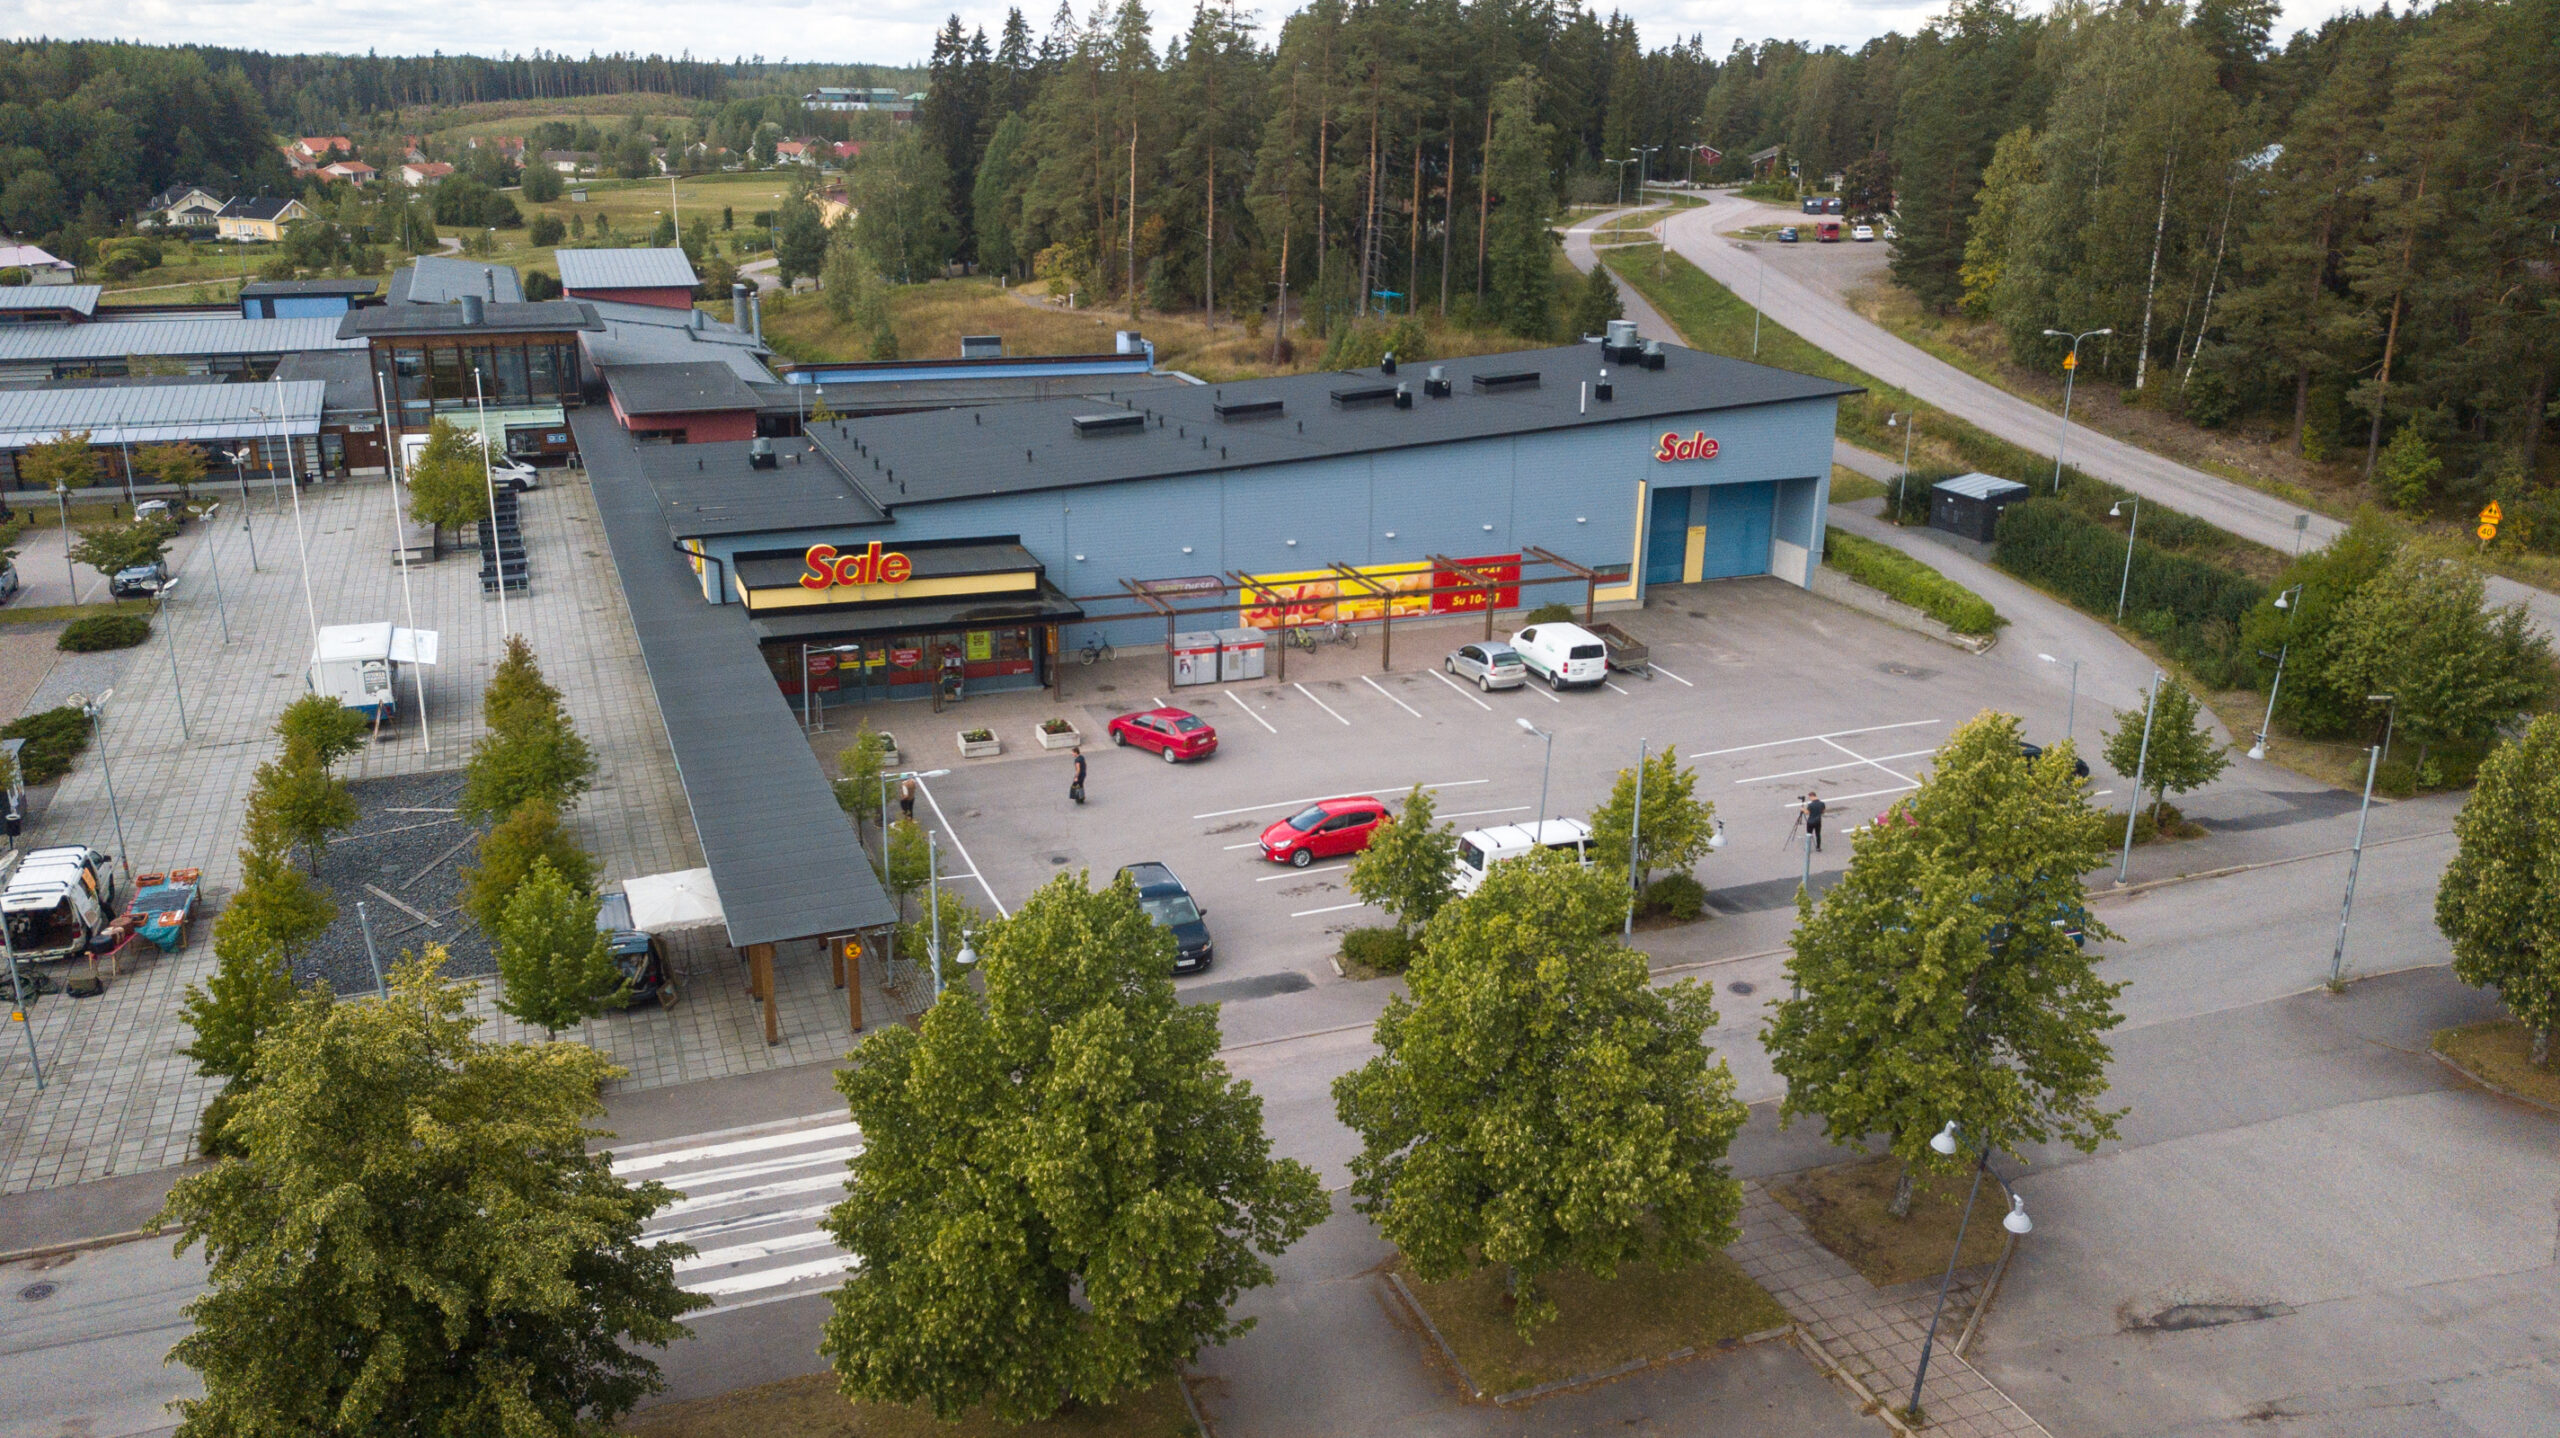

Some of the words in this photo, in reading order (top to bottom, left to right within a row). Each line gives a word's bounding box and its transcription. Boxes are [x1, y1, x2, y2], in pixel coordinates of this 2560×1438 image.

[1655, 431, 1719, 463] Sale
[2481, 528, 2493, 536] 40
[799, 541, 912, 590] Sale
[1250, 585, 1321, 619] Sale
[1452, 595, 1466, 606] Su
